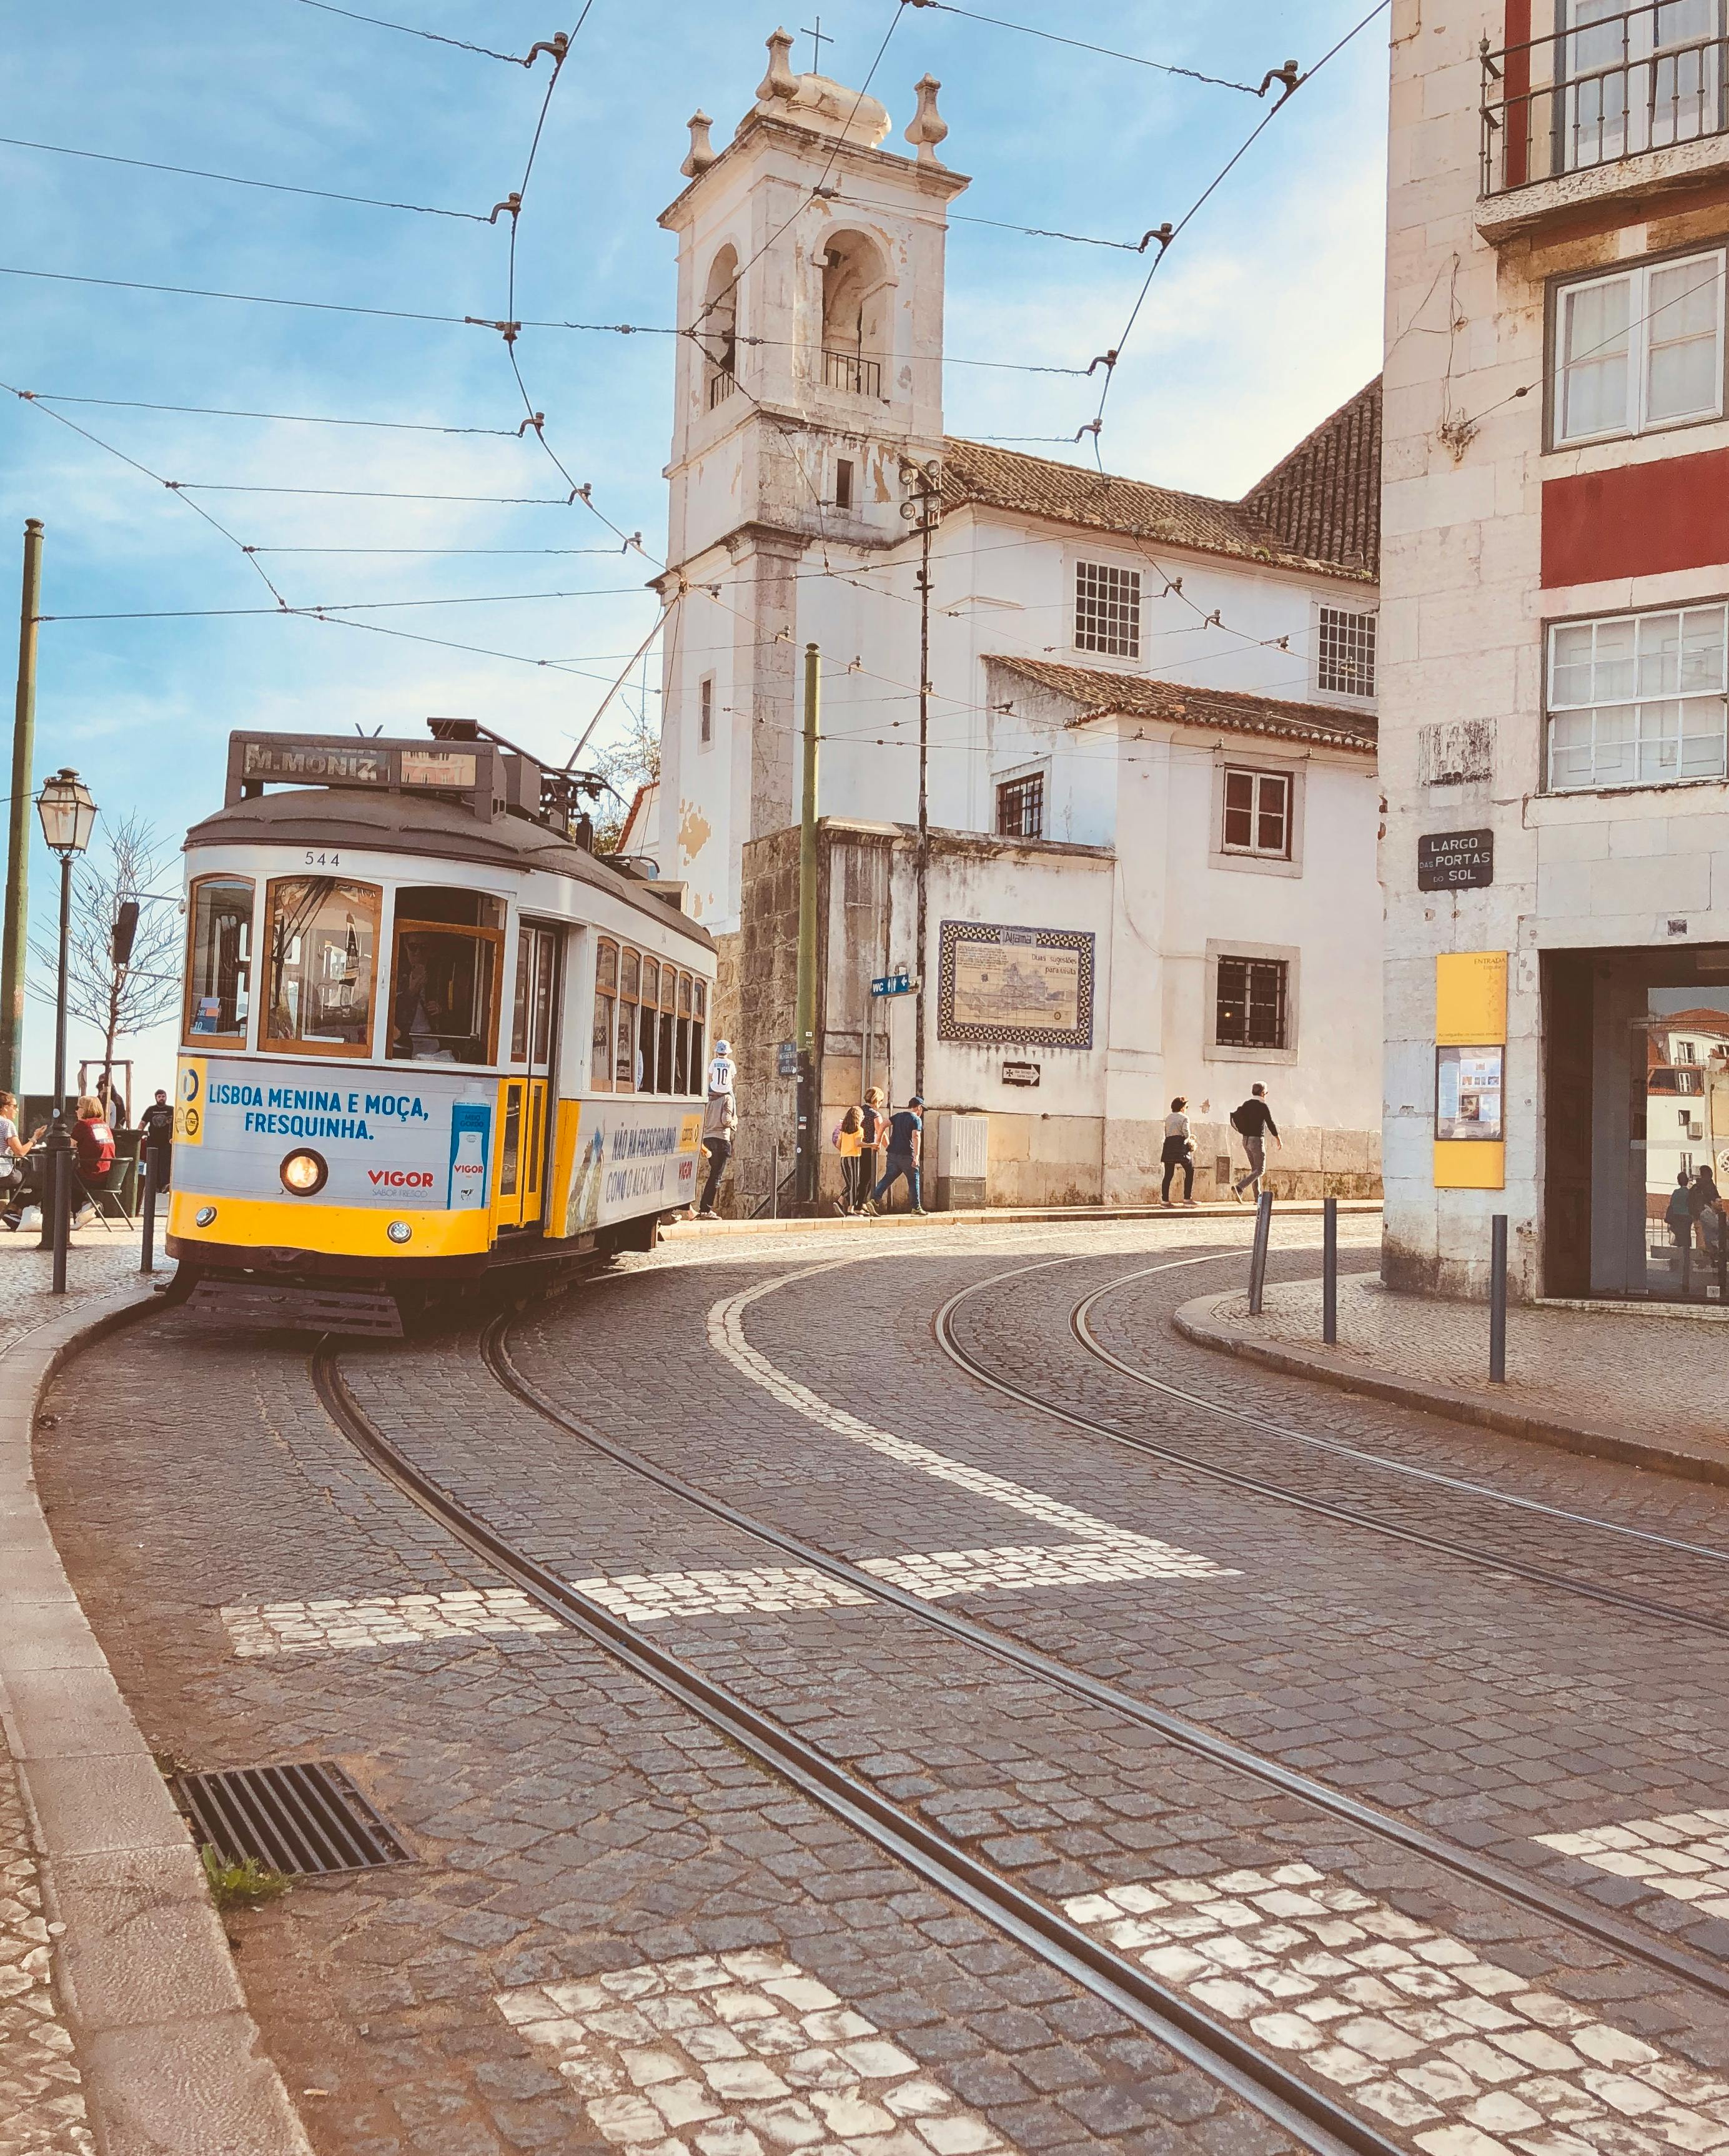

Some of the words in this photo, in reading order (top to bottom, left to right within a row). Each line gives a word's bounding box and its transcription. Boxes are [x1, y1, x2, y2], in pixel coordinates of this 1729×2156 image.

[1431, 838, 1478, 852] LARGO
[305, 851, 340, 866] 544
[1435, 852, 1490, 867] PORTAS
[1449, 869, 1477, 881] SOL
[1004, 931, 1032, 945] Alfama
[1031, 953, 1046, 961] Duas
[1050, 956, 1077, 965] sugestões
[1045, 966, 1059, 974] para
[873, 982, 884, 992] WC
[716, 1068, 728, 1085] 10
[209, 1084, 263, 1107] LISBOA
[268, 1088, 342, 1112] MENINA
[348, 1093, 359, 1113] E
[365, 1094, 429, 1122] MOÇA,
[245, 1112, 374, 1140] FRESQUINHA.
[612, 1122, 627, 1160] NÃO
[627, 1120, 638, 1159] HÁ
[454, 1165, 483, 1174] VIGOR
[367, 1169, 434, 1188] VIGOR
[606, 1169, 627, 1204] COMO
[627, 1169, 633, 1199] O
[632, 1164, 665, 1197] ALFACINHA
[372, 1188, 397, 1197] SABOR
